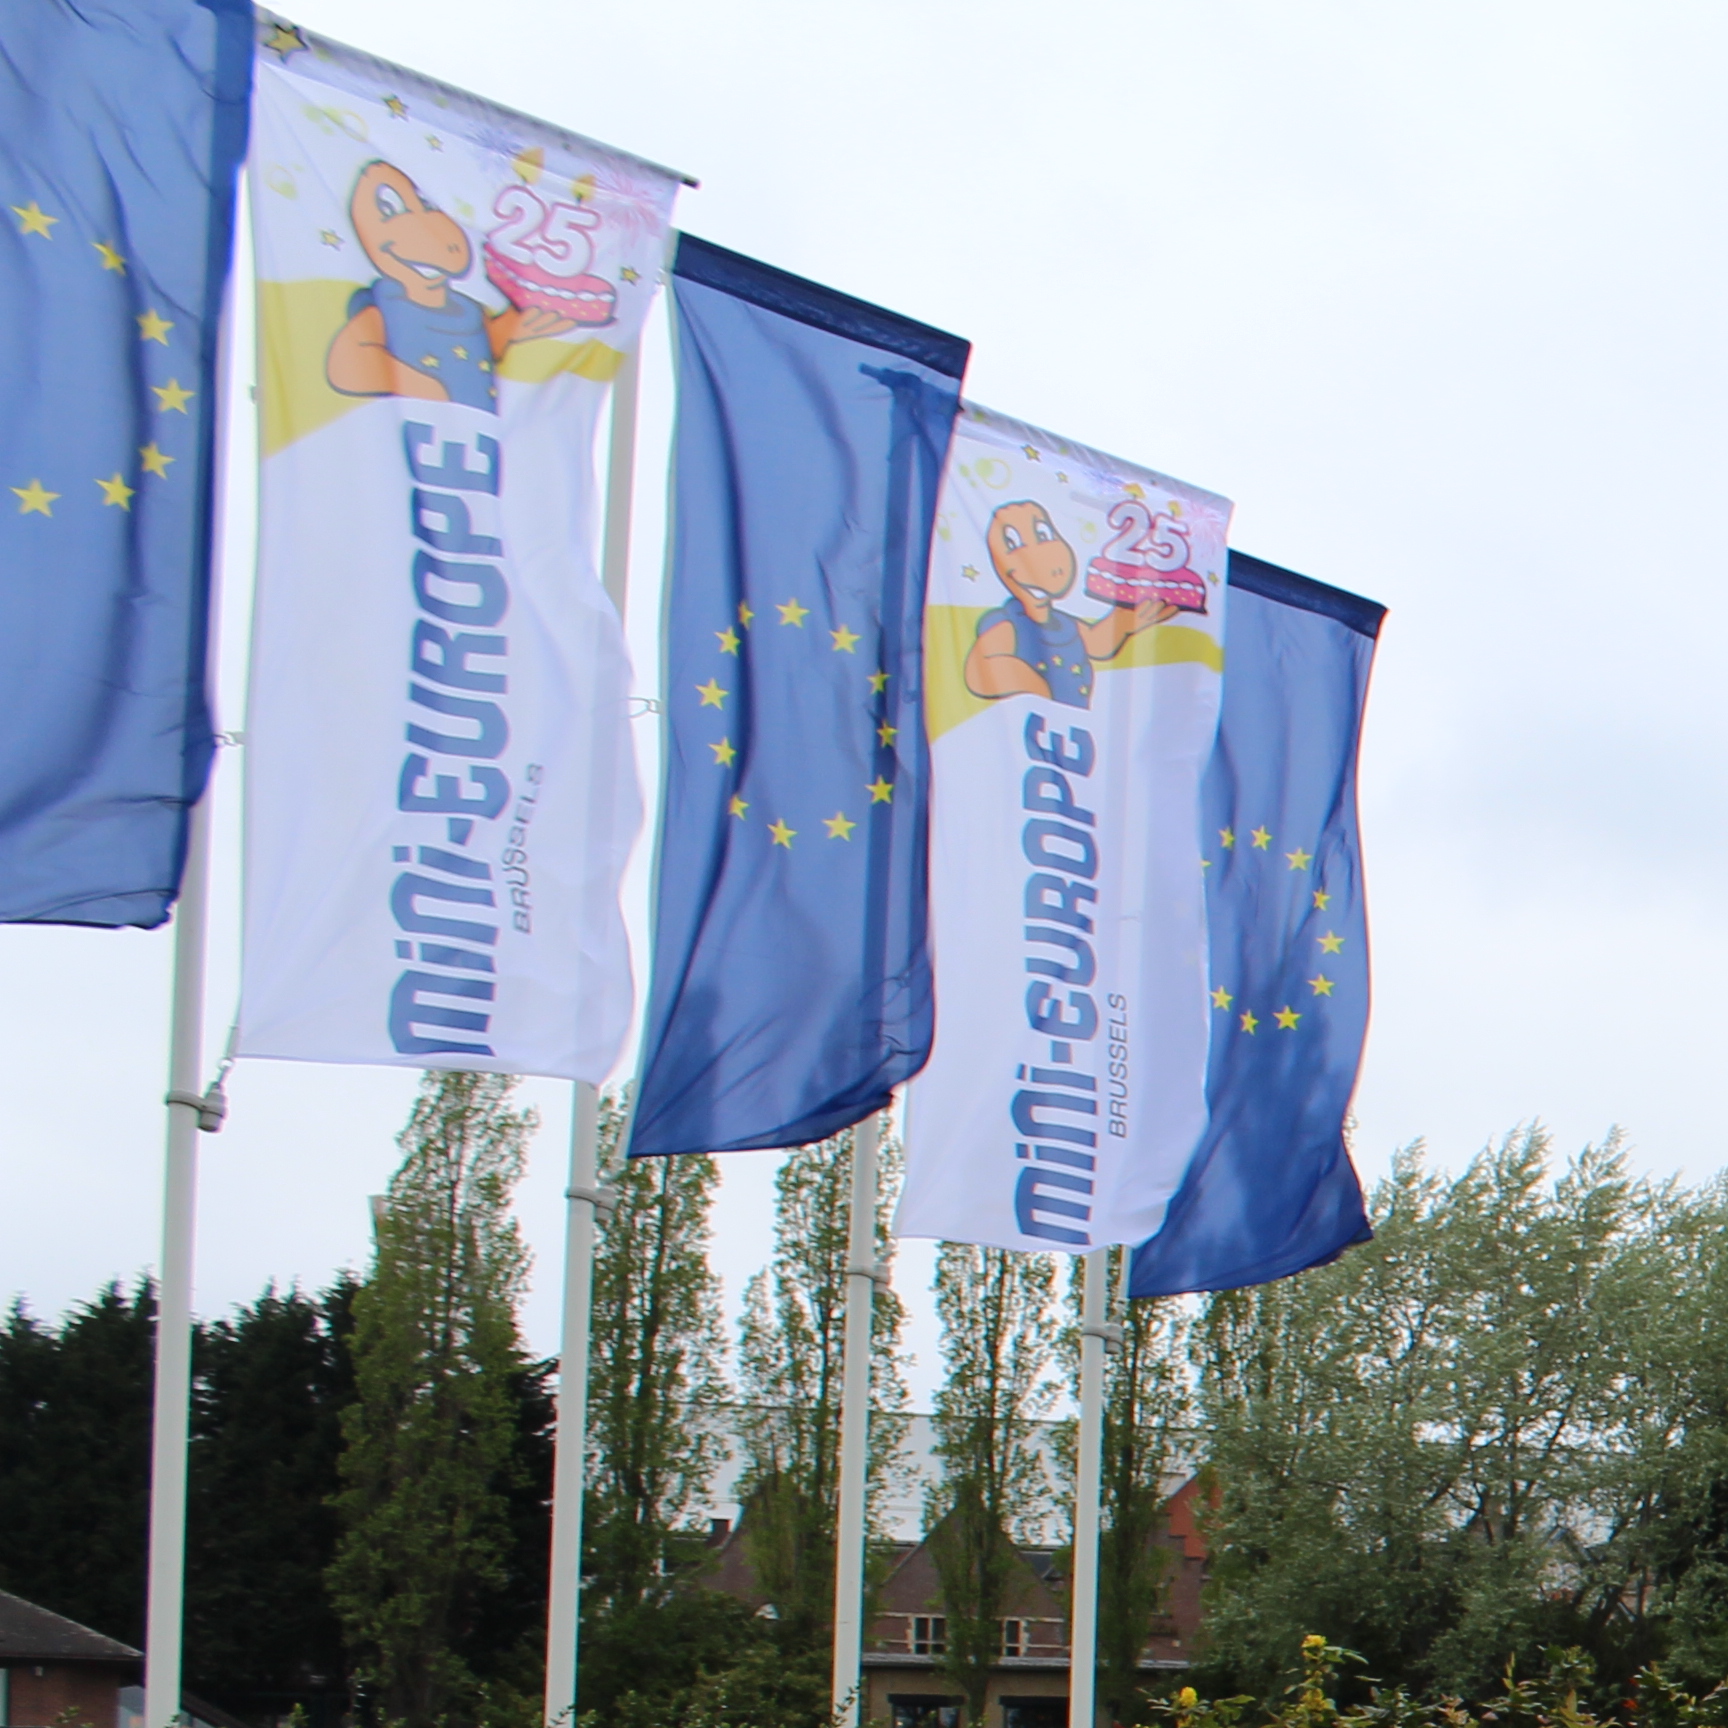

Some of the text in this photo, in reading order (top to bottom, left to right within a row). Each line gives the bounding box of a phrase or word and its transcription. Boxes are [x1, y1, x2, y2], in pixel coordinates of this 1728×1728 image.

[488, 185, 603, 277] 25
[1102, 499, 1192, 571] 25
[501, 763, 544, 935] BRUSSELS
[1108, 992, 1128, 1139] BRUSSELS
